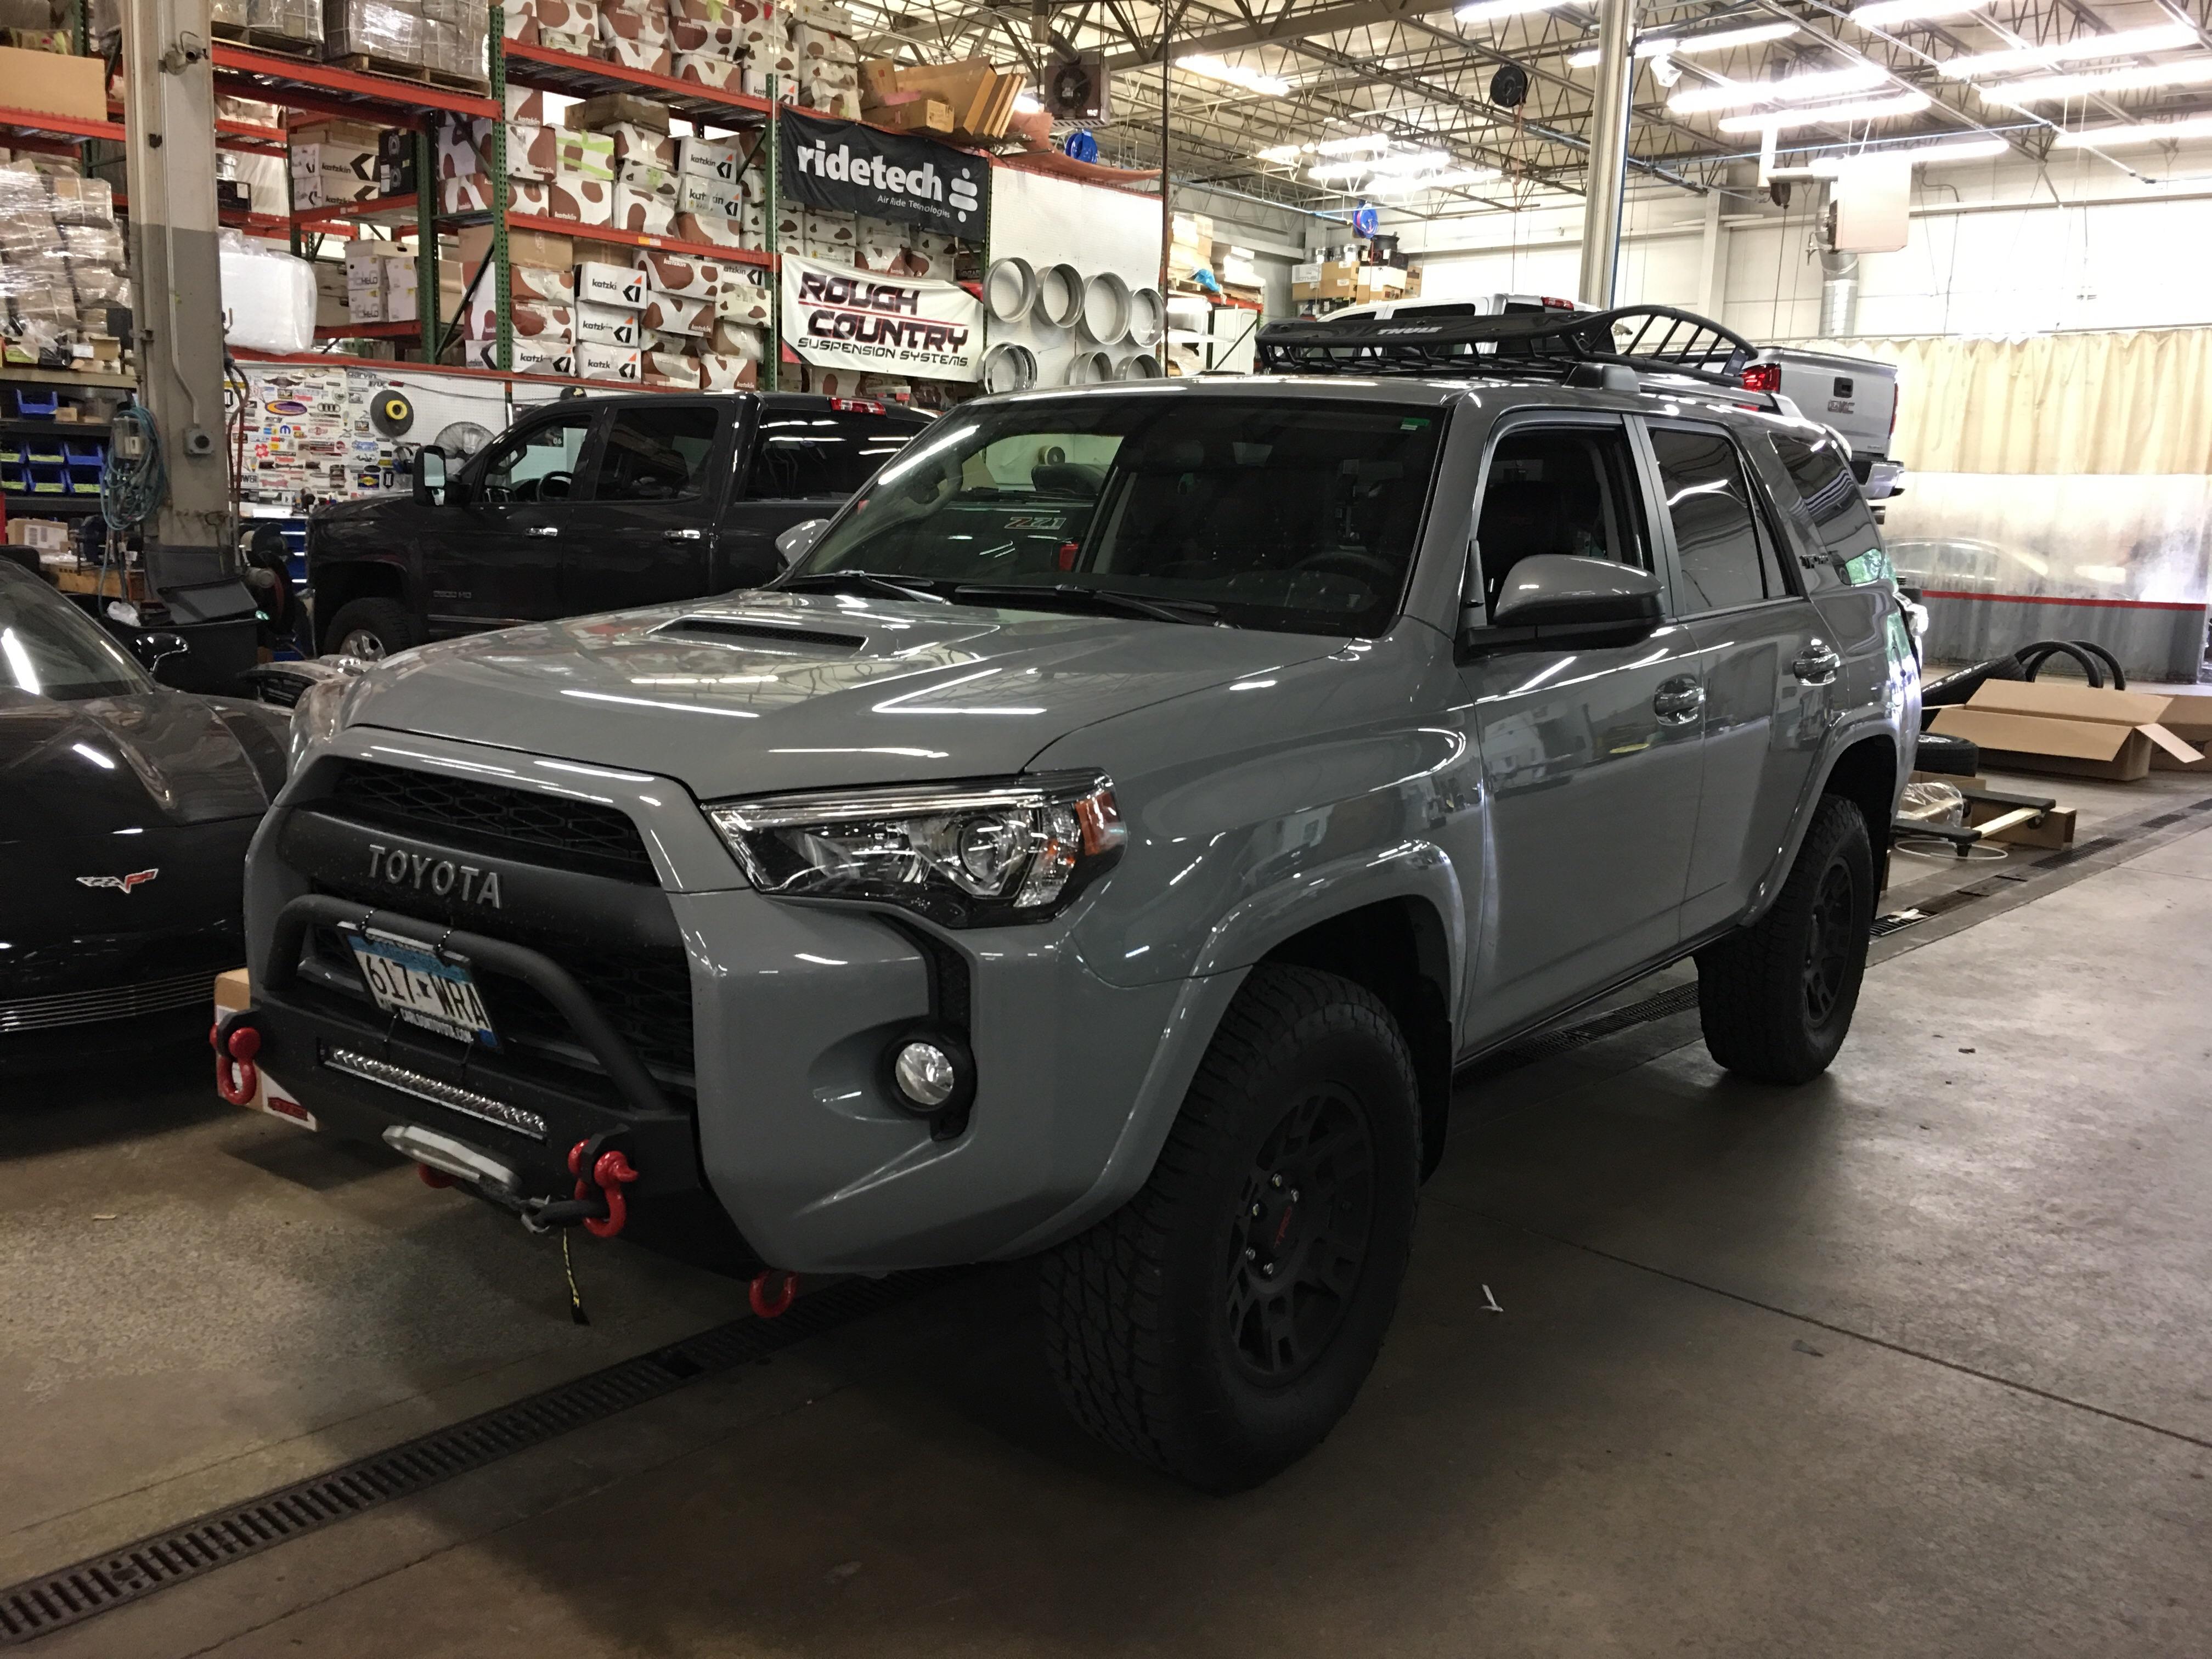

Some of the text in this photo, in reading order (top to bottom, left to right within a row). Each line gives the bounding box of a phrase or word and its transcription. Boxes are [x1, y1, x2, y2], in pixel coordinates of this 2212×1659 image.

[518, 115, 540, 125] katzkin
[691, 154, 715, 167] katzkin
[321, 162, 351, 174] katzkin
[797, 139, 943, 202] ridetech
[877, 195, 889, 204] Air
[890, 197, 906, 207] Ride
[555, 211, 577, 221] katzkin
[724, 266, 746, 275] atzkin
[592, 278, 617, 290] katzki
[798, 271, 921, 316] ROUGH
[807, 309, 968, 354] COUNTRY
[1377, 326, 1443, 335] THULE
[797, 337, 968, 367] SUSPENSION SYSTEMS
[1004, 517, 1067, 530] Z71
[369, 844, 500, 909] TOYOTA
[366, 955, 416, 1005] 617
[428, 973, 489, 1029] WRA
